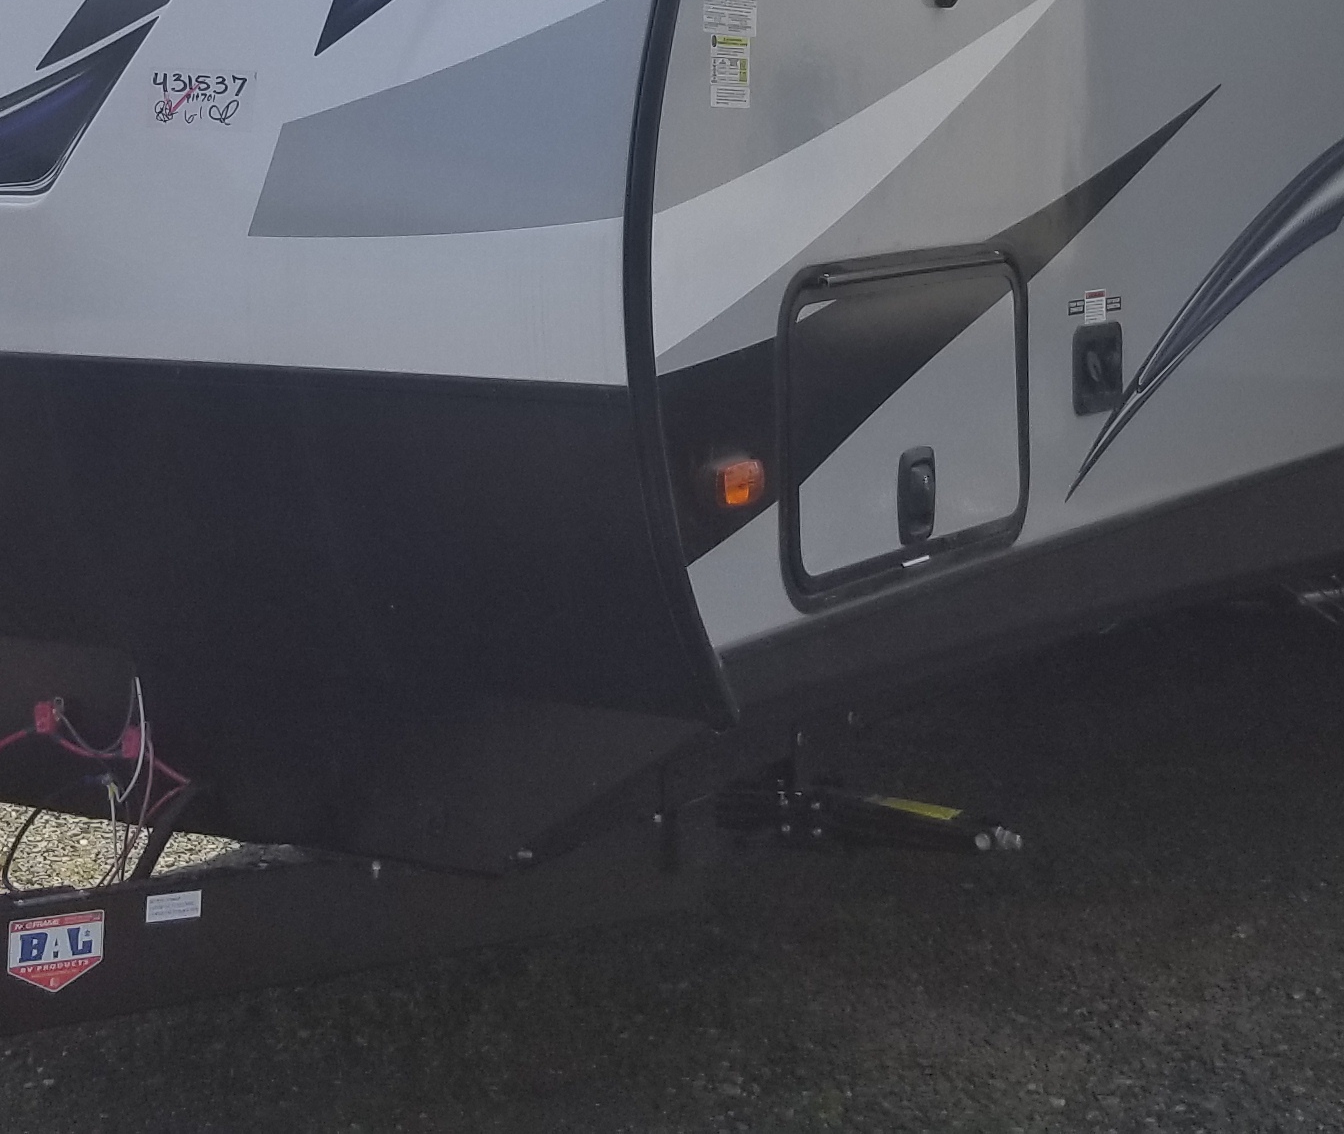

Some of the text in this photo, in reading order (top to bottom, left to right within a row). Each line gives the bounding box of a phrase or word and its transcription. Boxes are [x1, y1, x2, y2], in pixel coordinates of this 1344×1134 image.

[152, 72, 248, 97] 431537
[18, 926, 93, 964] BAL
[36, 959, 89, 972] PRODUCTS
